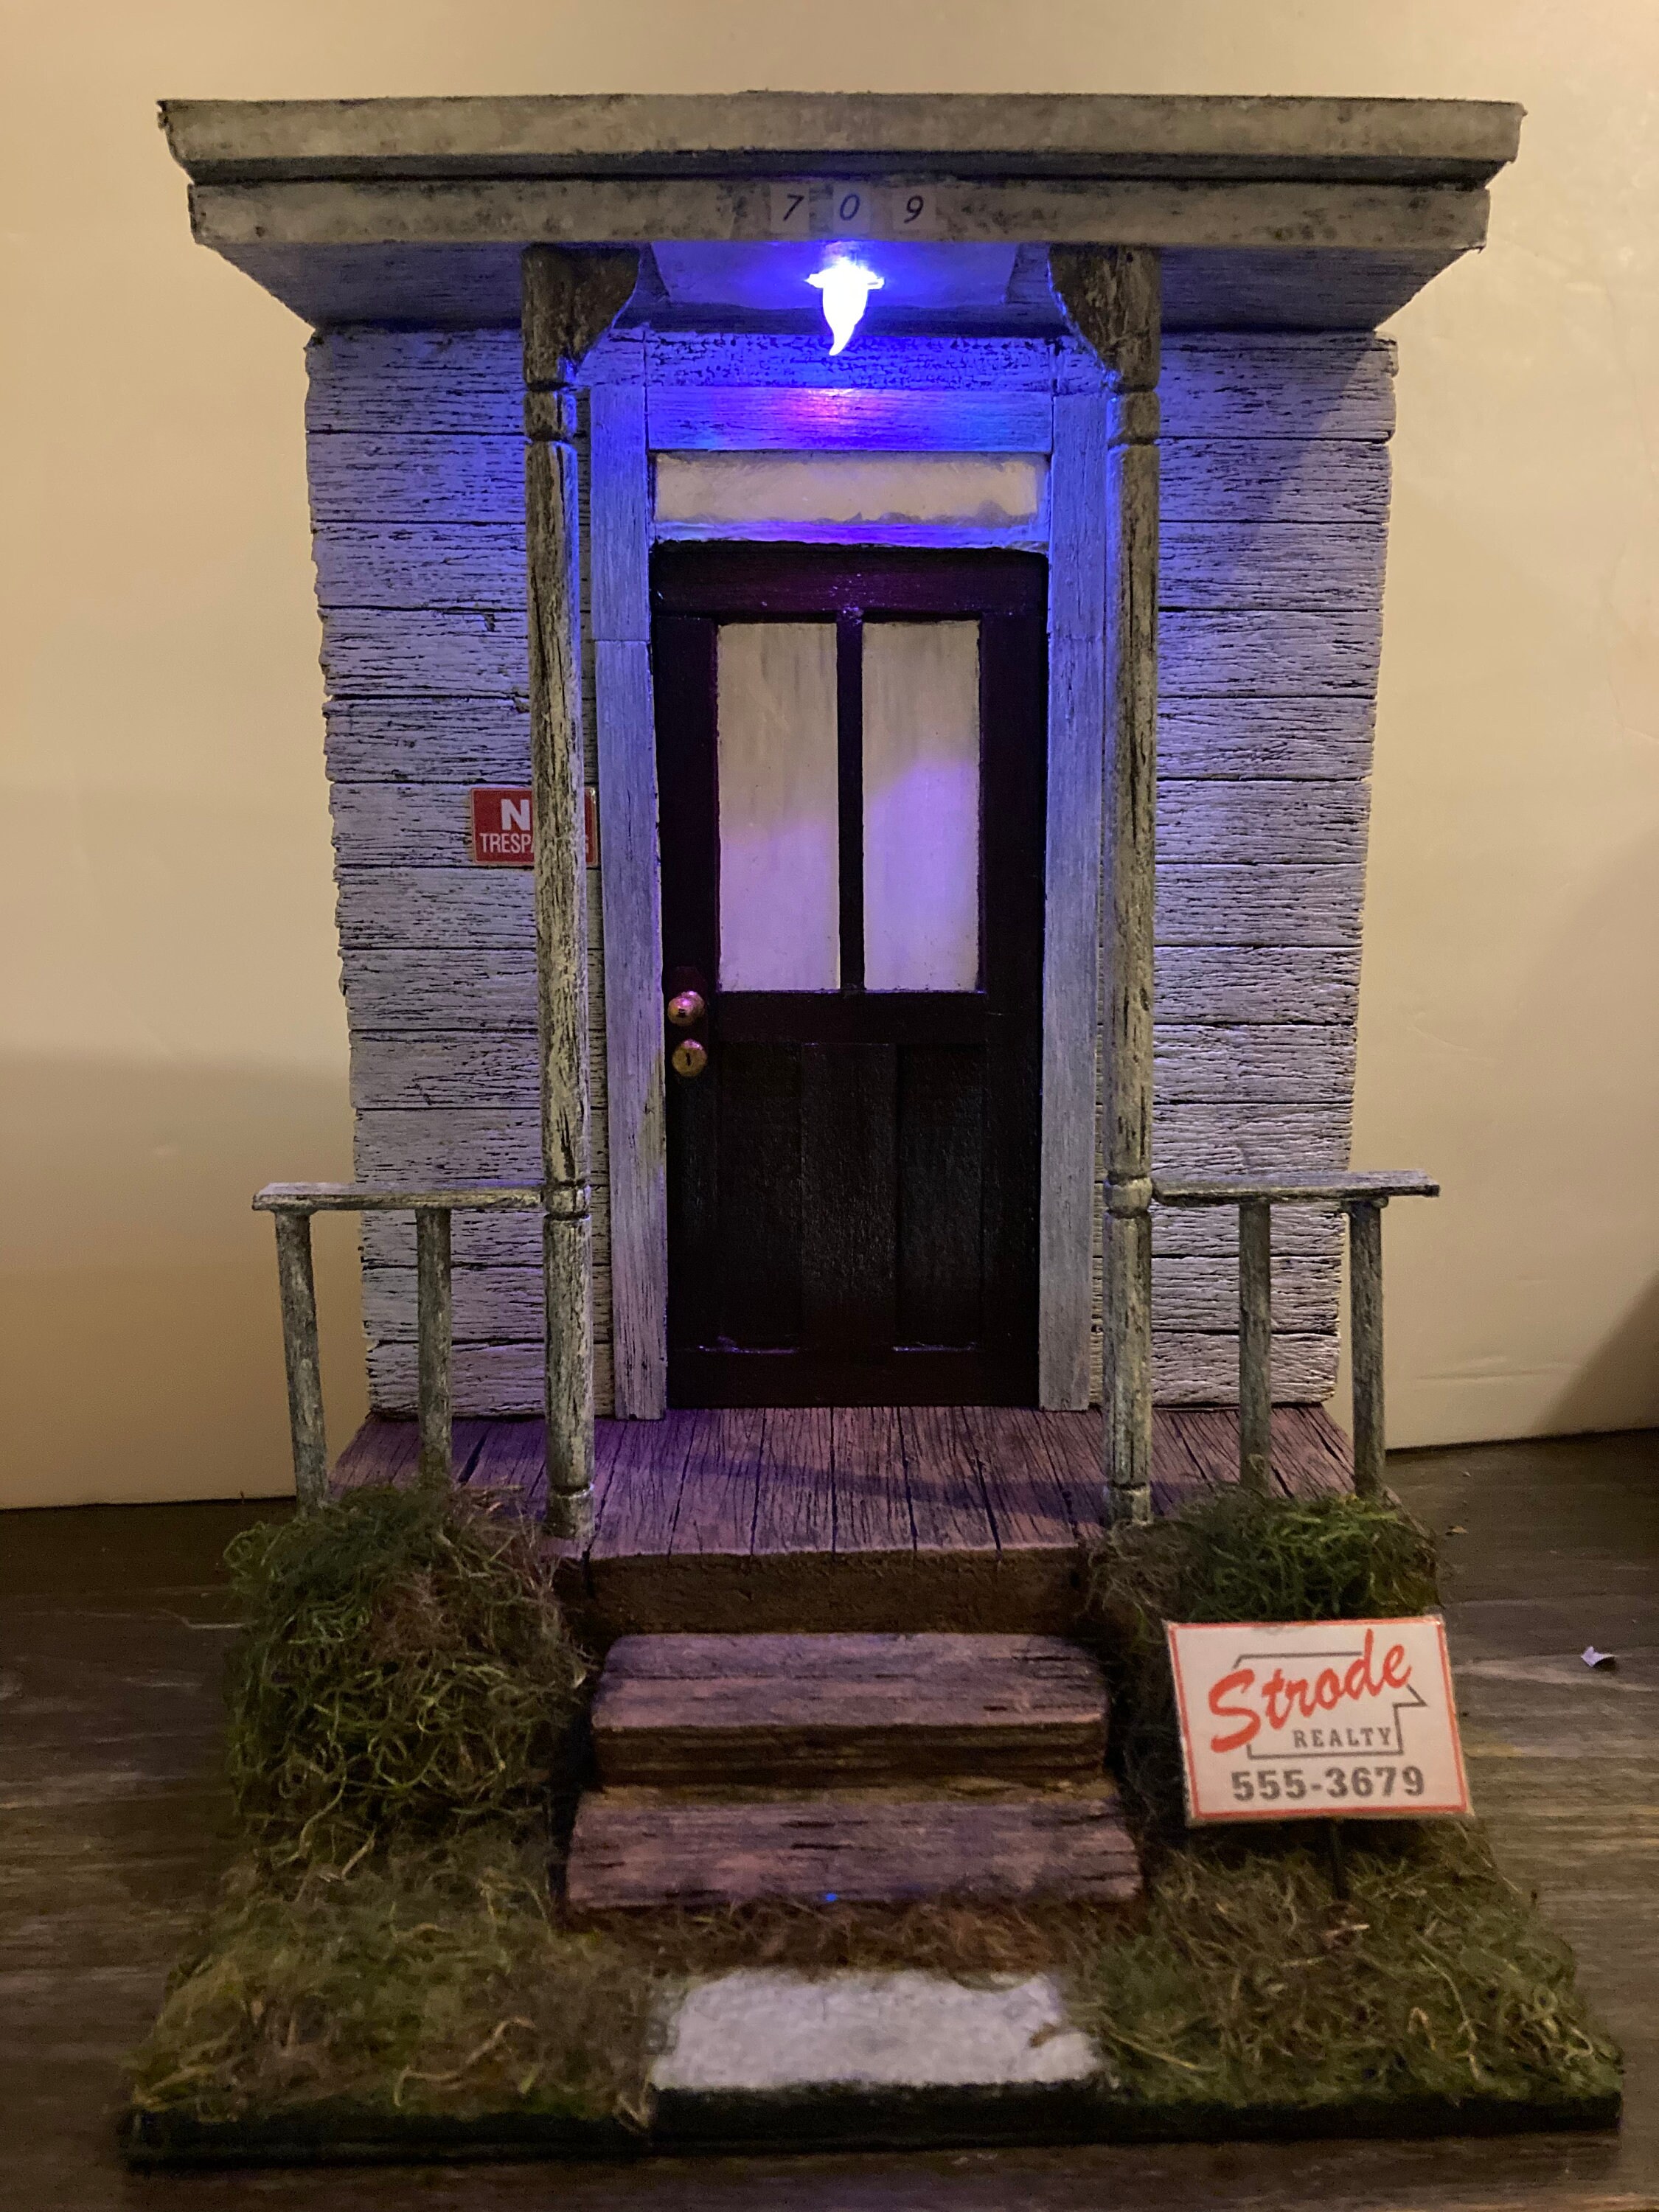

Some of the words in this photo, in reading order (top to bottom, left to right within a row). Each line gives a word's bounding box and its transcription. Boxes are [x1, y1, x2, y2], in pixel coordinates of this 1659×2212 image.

[501, 799, 532, 831] N
[1208, 1628, 1412, 1753] Strode
[1293, 1727, 1392, 1748] REALTY
[1231, 1765, 1425, 1801] 555-3679
